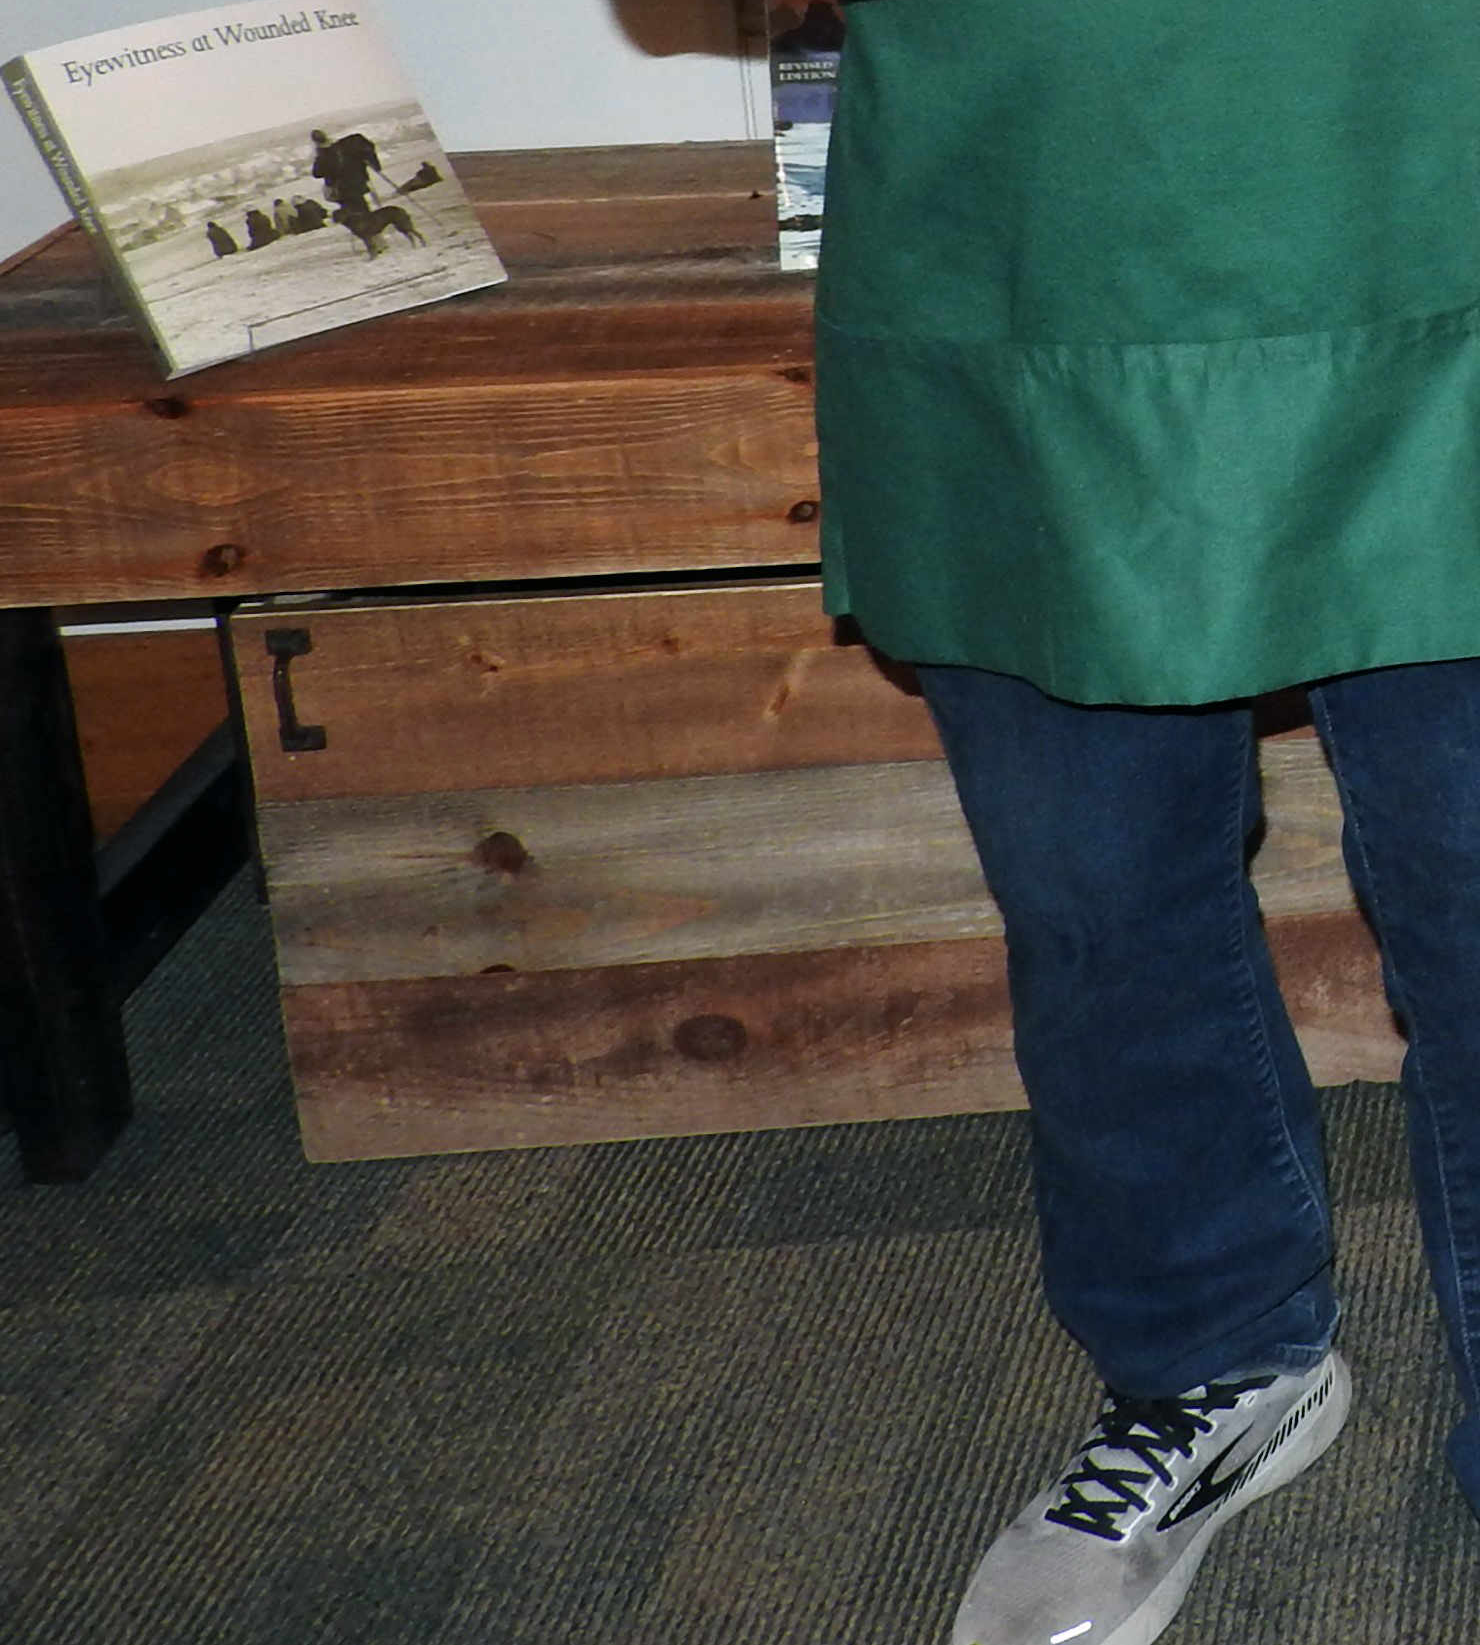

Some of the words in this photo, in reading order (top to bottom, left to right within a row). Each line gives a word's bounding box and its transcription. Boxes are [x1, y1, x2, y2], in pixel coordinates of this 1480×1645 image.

[61, 38, 187, 87] Eyewitness
[191, 28, 214, 55] at
[214, 11, 313, 50] Wounded
[314, 7, 360, 32] Knee
[779, 70, 838, 82] EDITION
